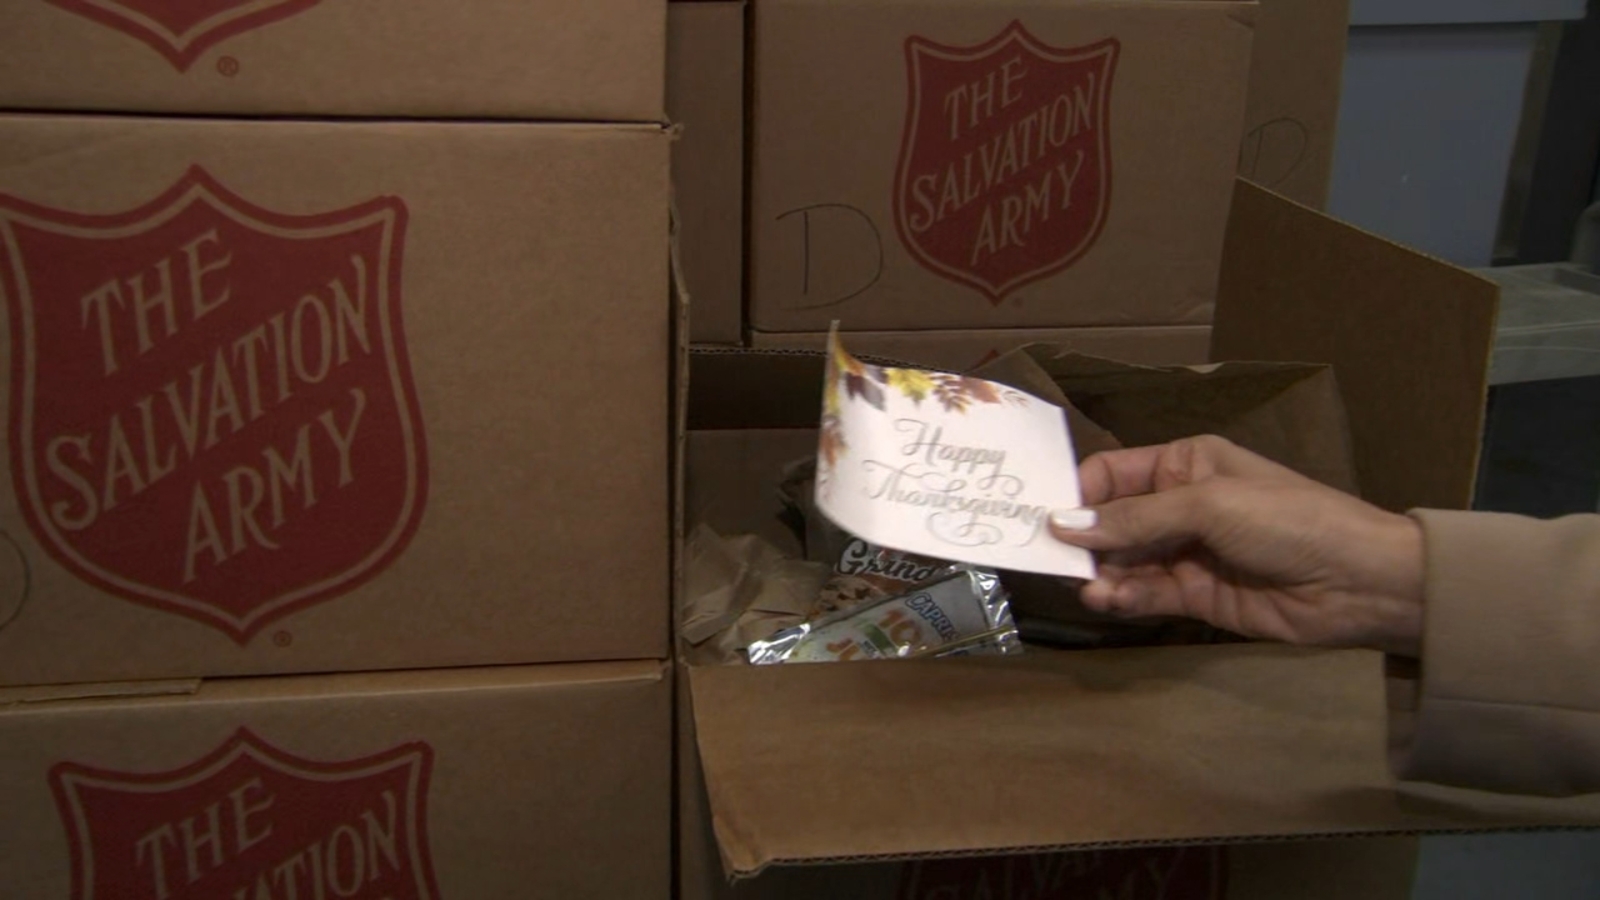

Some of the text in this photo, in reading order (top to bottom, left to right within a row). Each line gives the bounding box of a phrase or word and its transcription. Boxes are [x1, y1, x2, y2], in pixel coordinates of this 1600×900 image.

[909, 72, 1098, 232] SALVATION
[943, 54, 1029, 141] THE
[776, 203, 883, 309] D
[970, 150, 1085, 266] ARMY
[80, 228, 232, 377] THE
[46, 254, 373, 532] SALVATION
[183, 388, 367, 585] ARMY
[862, 459, 1050, 547] Thanksgiving
[894, 418, 1024, 496] Happy
[135, 776, 275, 900] THE
